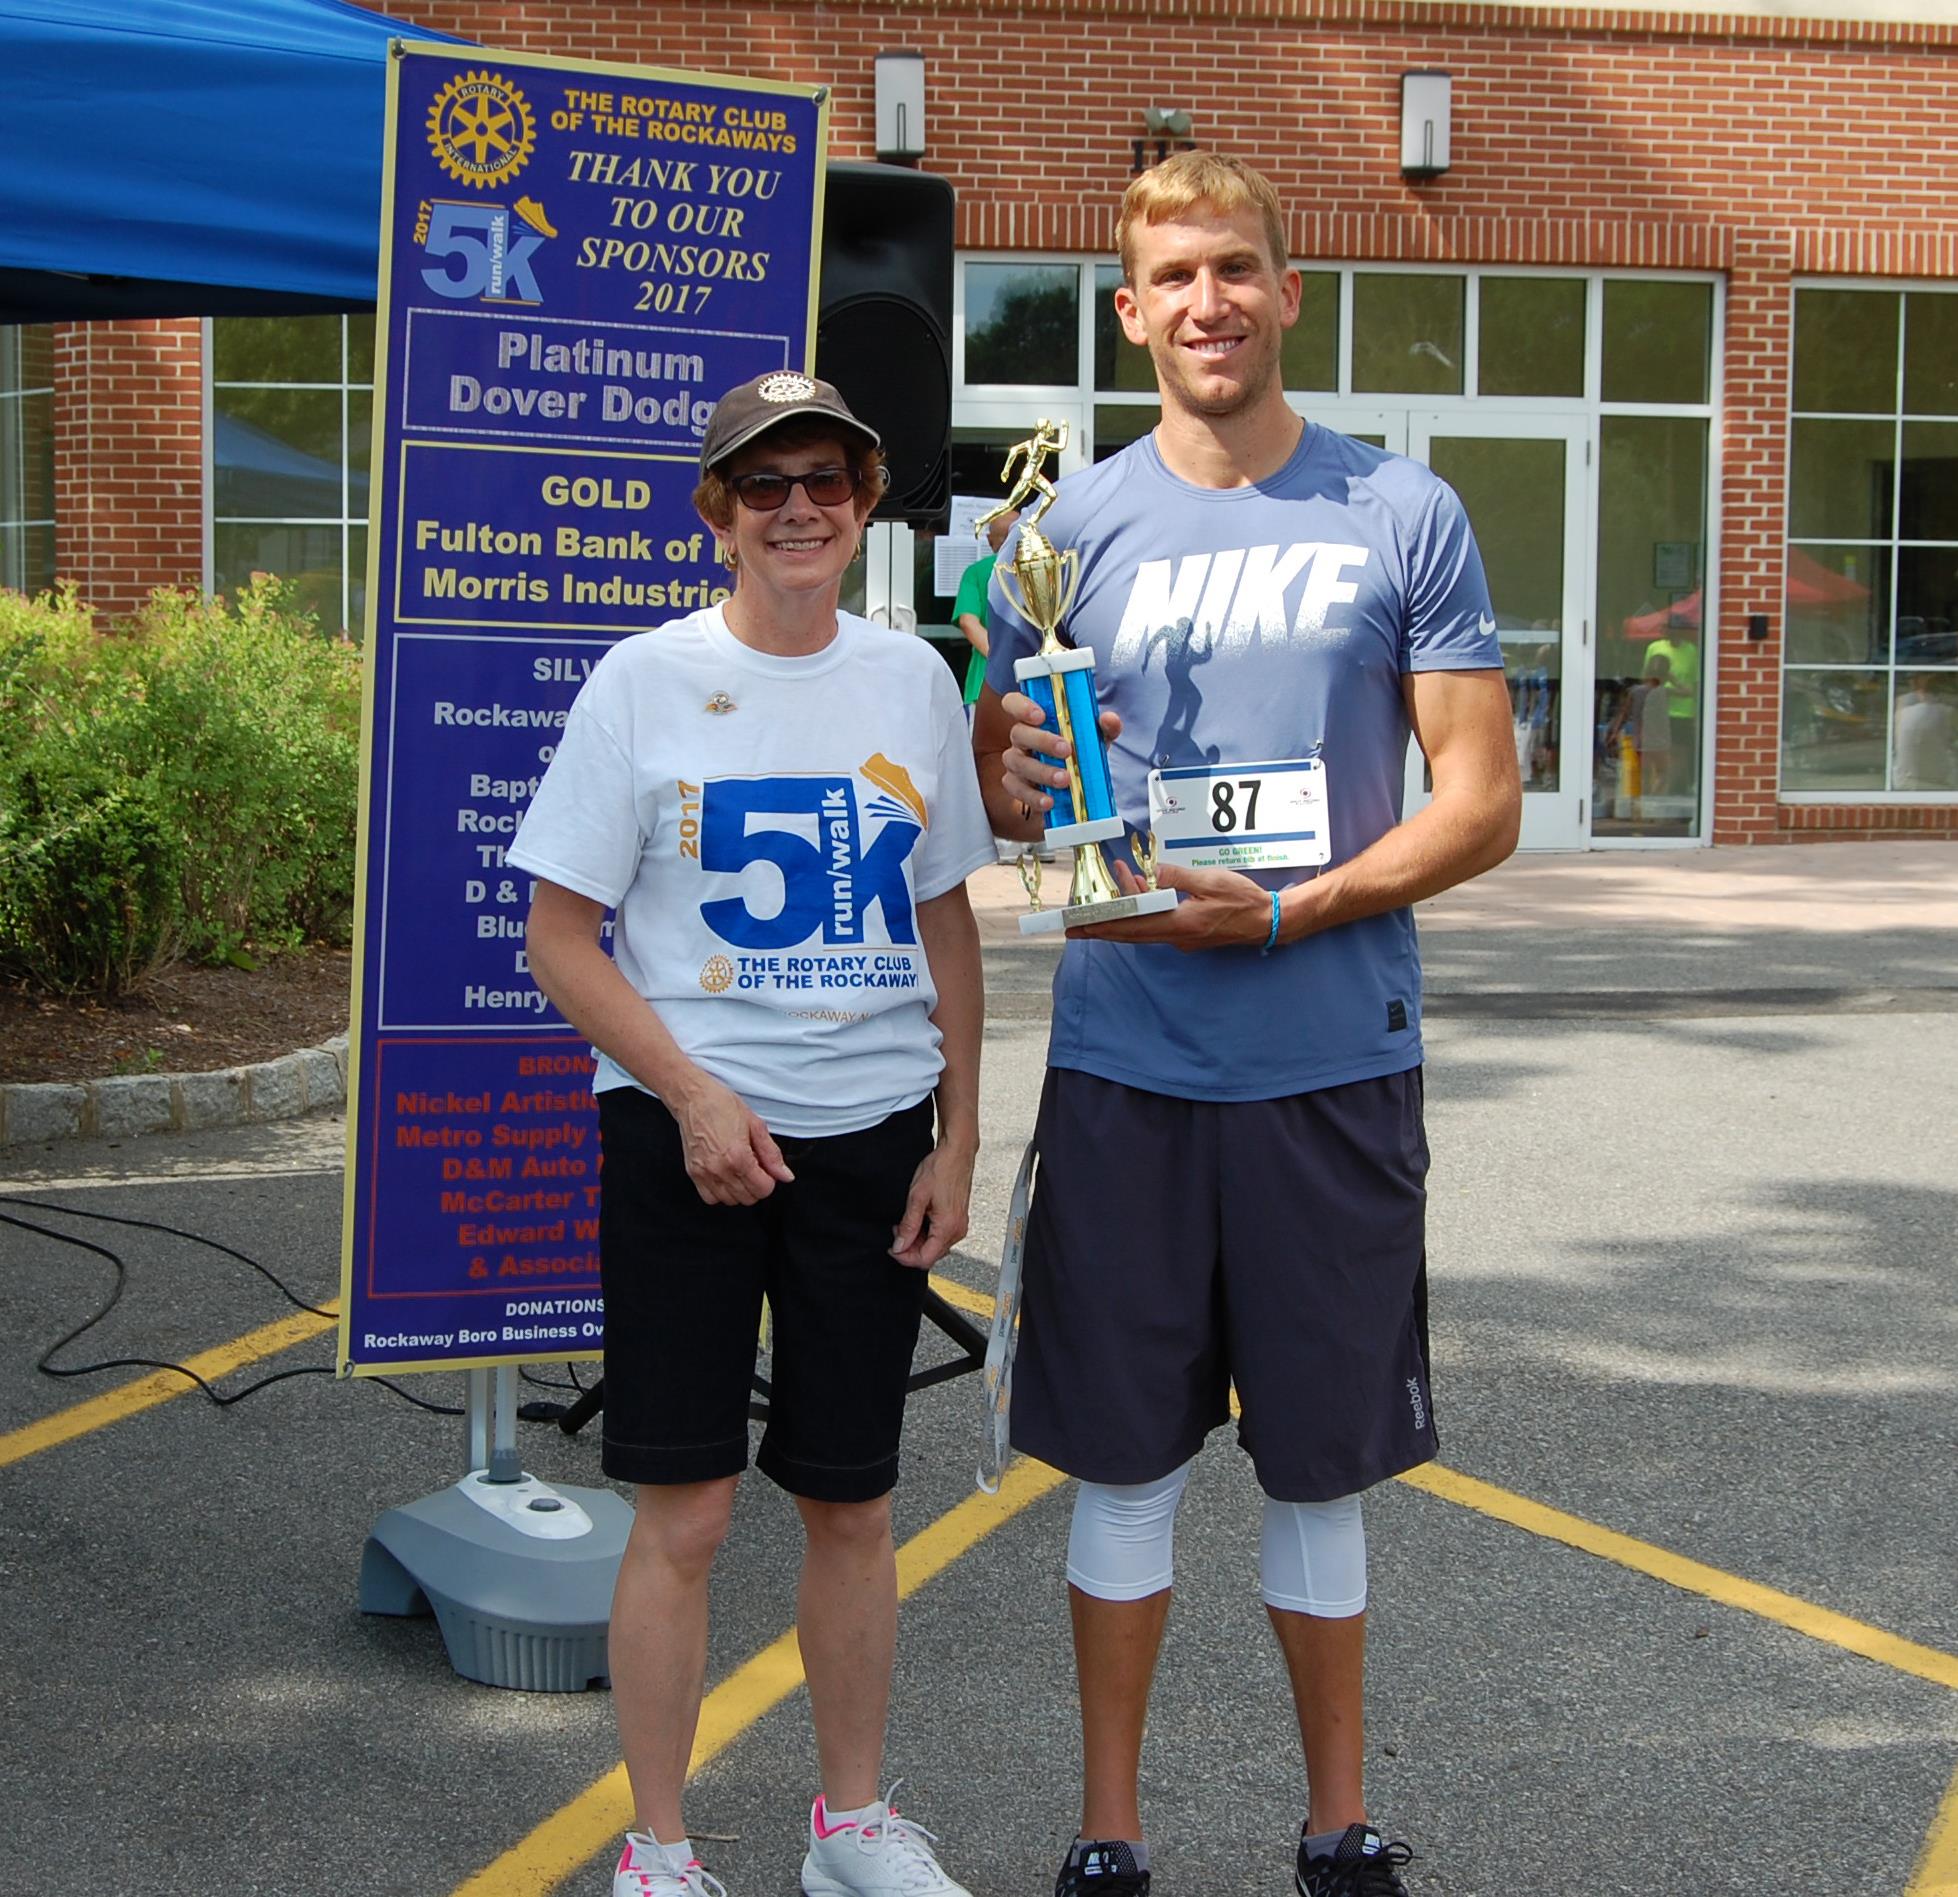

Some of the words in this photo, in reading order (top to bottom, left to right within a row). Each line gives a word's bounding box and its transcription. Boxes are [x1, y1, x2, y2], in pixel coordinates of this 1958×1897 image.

[461, 85, 505, 97] ROTARY
[564, 89, 613, 112] THE
[621, 96, 716, 123] ROTARY
[724, 108, 787, 131] CLUB
[551, 111, 584, 131] OF
[592, 115, 640, 137] THE
[648, 120, 797, 154] ROCKAWAYS
[445, 142, 517, 172] INTERNATIONAL
[568, 151, 699, 193] THANK
[709, 166, 782, 199] YOU
[413, 200, 433, 245] 2017
[609, 197, 660, 230] TO
[667, 203, 745, 238] OUR
[490, 215, 504, 294] run/walk
[576, 237, 770, 281] SPONSORS
[634, 281, 711, 314] 2017
[498, 332, 704, 382] Platinum
[450, 375, 587, 419] Dover
[602, 385, 716, 436] Dodg
[541, 476, 651, 510] GOLD
[416, 520, 542, 555] Fulton
[556, 527, 652, 561] Bank
[665, 534, 703, 563] of
[424, 568, 549, 602] Morris
[1110, 542, 1369, 667] NIKE
[676, 779, 701, 860] 2017
[1212, 780, 1261, 833] 87
[821, 787, 854, 936] run/walk
[1192, 858, 1216, 867] Please
[1218, 856, 1241, 865] return
[465, 880, 486, 903] D
[496, 880, 518, 904] &
[737, 957, 780, 972] THE
[787, 956, 867, 972] ROTARY
[874, 956, 911, 971] CLUB
[737, 975, 765, 988] OF
[773, 974, 813, 989] THE
[465, 986, 548, 1014] Henry
[396, 1092, 490, 1114] Nickel
[396, 1125, 482, 1148] Metro
[492, 1122, 586, 1149] Supply
[442, 1158, 512, 1180] D&M
[521, 1155, 586, 1178] Auto
[440, 1188, 574, 1213] McCarter
[458, 1220, 565, 1246] Edward
[468, 1257, 488, 1279] &
[364, 1331, 454, 1348] Rockaway
[458, 1329, 497, 1343] Boro
[502, 1324, 578, 1341] Business
[1406, 1377, 1425, 1430] Reebok
